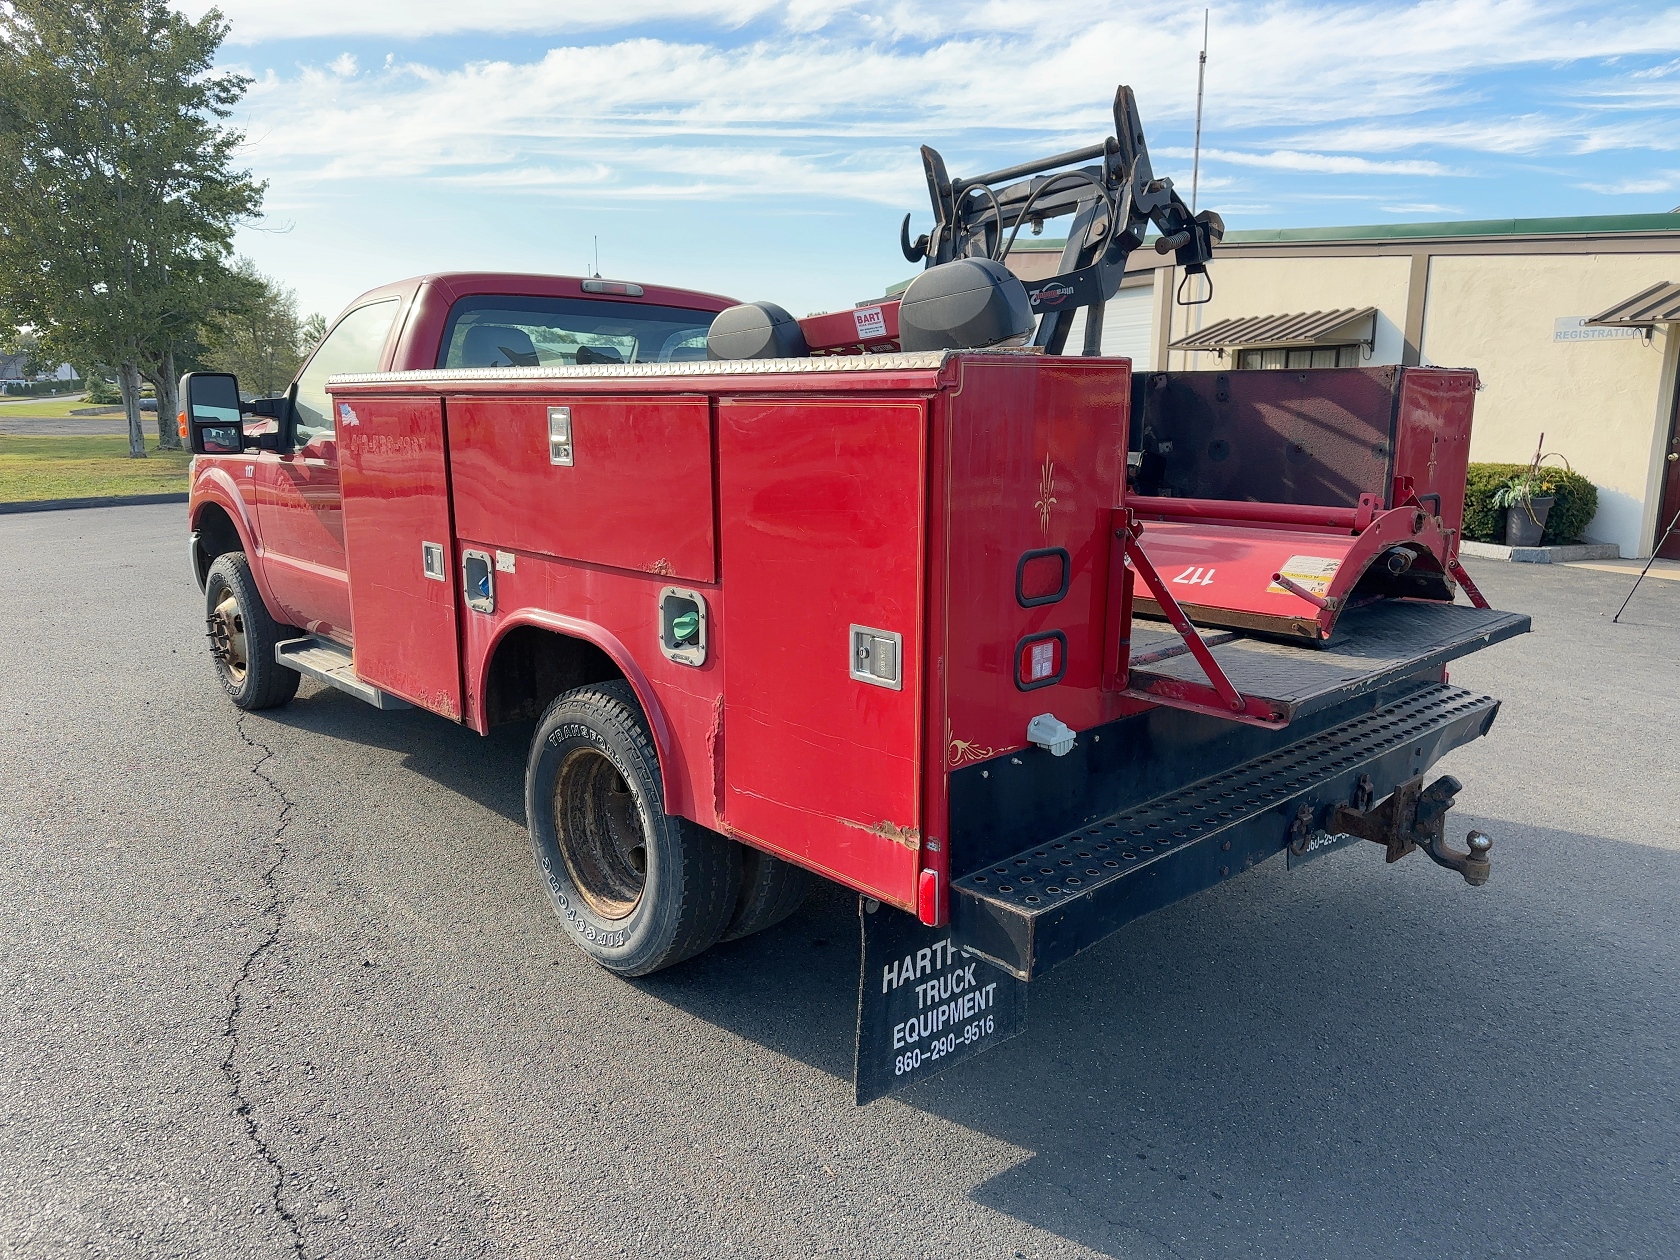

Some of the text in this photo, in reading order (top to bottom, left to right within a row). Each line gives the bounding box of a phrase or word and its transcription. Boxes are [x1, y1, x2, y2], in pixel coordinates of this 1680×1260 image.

[857, 312, 880, 324] BART
[244, 465, 254, 478] 117
[1172, 566, 1216, 587] 117
[882, 937, 971, 994] HARTF
[915, 962, 977, 1010] TRUCK
[893, 982, 997, 1050] EQUIPMENT
[895, 1014, 995, 1076] 860-290-9516
